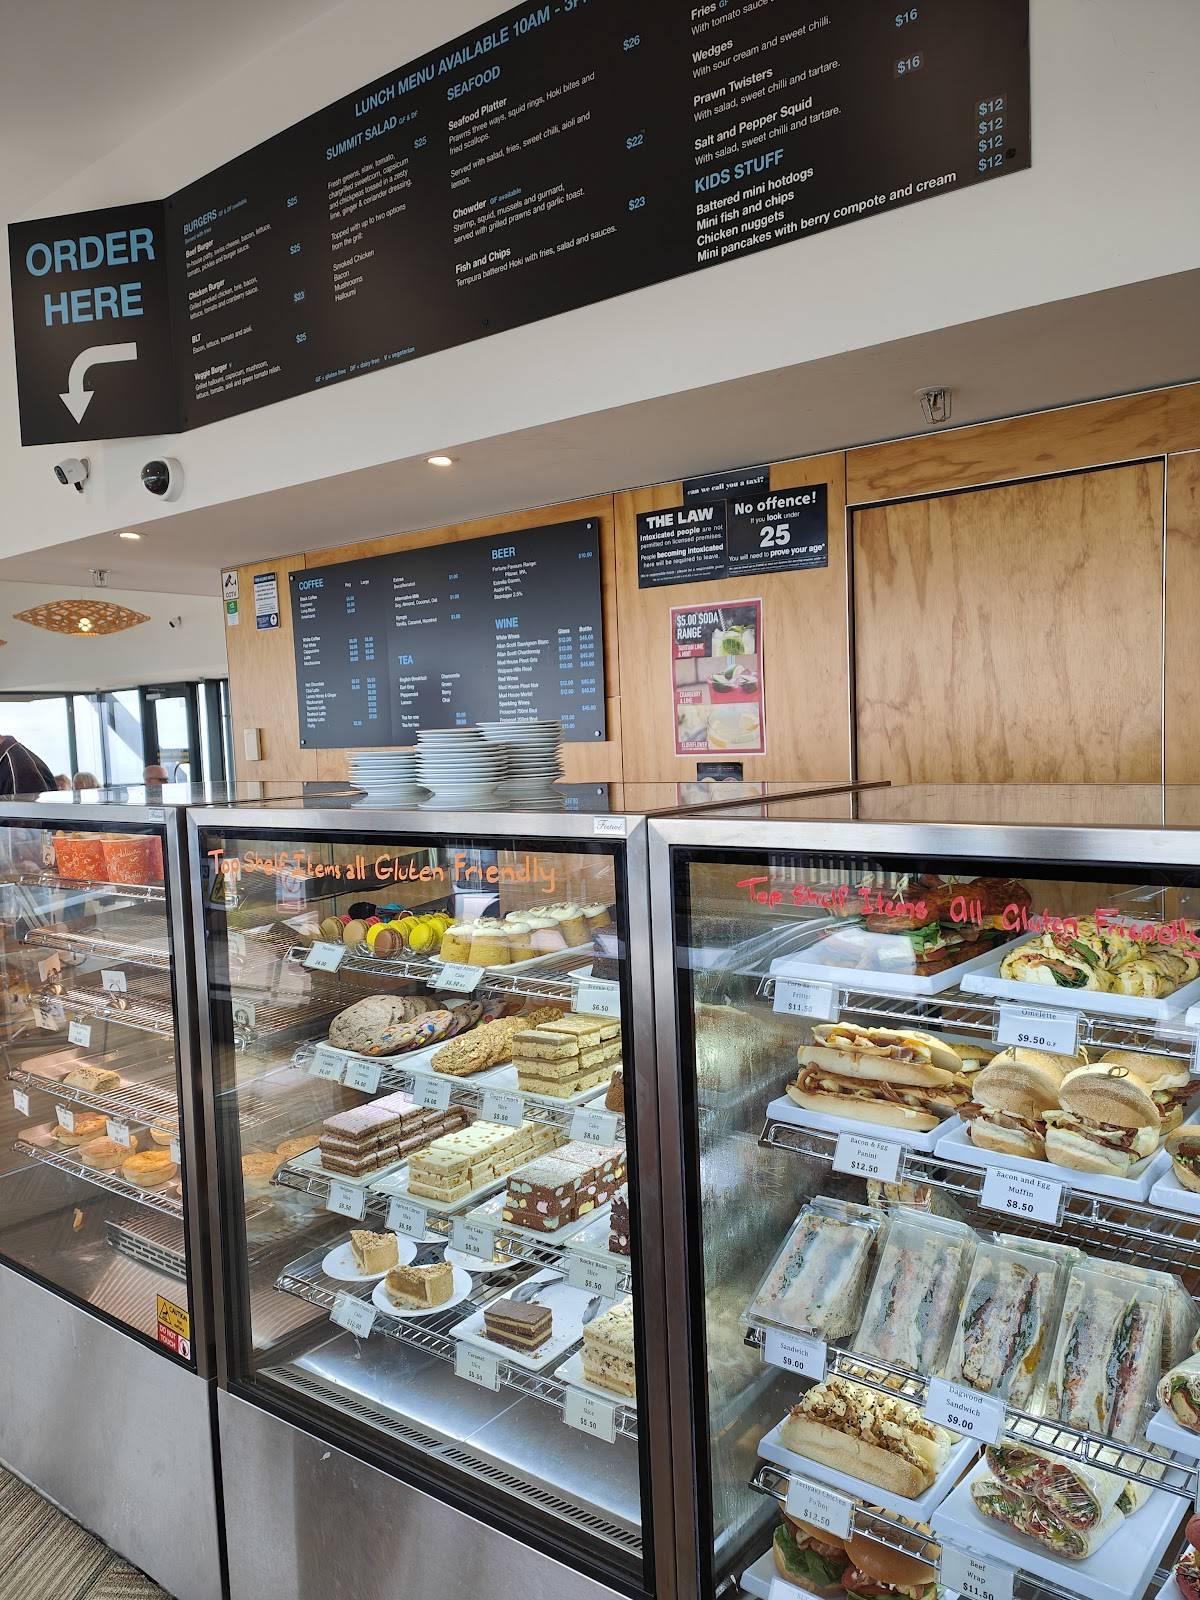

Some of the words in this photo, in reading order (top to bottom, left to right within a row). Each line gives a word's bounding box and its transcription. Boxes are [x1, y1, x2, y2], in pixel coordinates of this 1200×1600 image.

[691, 3, 717, 21] Fries
[895, 8, 918, 28] $16
[623, 35, 641, 52] $26
[692, 64, 711, 79] With
[712, 57, 732, 71] sour
[732, 47, 759, 63] cream
[761, 36, 778, 51] and
[779, 26, 806, 43] sweet
[808, 15, 832, 32] chilli.
[692, 39, 733, 63] Wedges
[355, 85, 395, 117] LUNCH
[398, 64, 435, 96] MENU
[438, 27, 509, 76] AVAILABLE
[512, 6, 550, 38] 10AM
[897, 55, 921, 74] $16
[447, 65, 501, 101] SEAFOOD
[693, 87, 726, 107] Prawn
[728, 68, 773, 93] Twisters
[448, 109, 480, 131] Seafood
[481, 97, 508, 119] Platter
[978, 98, 1004, 116] $12
[694, 133, 715, 150] Salt
[716, 126, 737, 142] and
[738, 111, 778, 134] Pepper
[780, 97, 813, 118] Squid
[978, 117, 1004, 135] $12
[326, 132, 363, 160] SUMMIT
[364, 116, 397, 142] SALAD
[413, 136, 428, 149] $25
[626, 134, 644, 150] $22
[694, 152, 714, 166] With
[715, 144, 740, 159] salad,
[741, 132, 767, 149] sweet
[768, 123, 789, 139] chilli
[790, 115, 807, 131] and
[809, 105, 841, 124] tartare.
[978, 135, 1003, 153] $12
[694, 169, 731, 193] KIDS
[734, 149, 784, 180] STUFF
[977, 154, 1003, 172] $12
[697, 191, 741, 216] Battered
[743, 184, 766, 200] mini
[768, 167, 814, 193] hotdogs
[452, 200, 487, 220] Chowder
[628, 196, 646, 211] $23
[697, 213, 718, 232] Mini
[720, 208, 740, 223] fish
[741, 202, 763, 217] and
[765, 189, 795, 211] chips
[183, 209, 218, 235] BURGERS
[697, 245, 719, 263] Mini
[721, 231, 772, 257] pancakes
[774, 223, 798, 238] with
[801, 211, 831, 232] berry
[833, 195, 886, 220] compote
[889, 184, 914, 200] and
[915, 171, 957, 193] cream
[697, 225, 739, 247] Chicken
[740, 209, 785, 234] nuggets
[26, 228, 155, 277] ORDER
[455, 260, 472, 275] Fish
[472, 255, 488, 268] and
[488, 248, 511, 263] Chips
[456, 271, 482, 287] Tempura
[482, 262, 508, 279] battered
[508, 256, 524, 270] Hoki
[525, 251, 539, 263] with
[539, 245, 556, 258] fries,
[556, 238, 575, 252] salad
[576, 233, 589, 246] and
[590, 225, 618, 241] sauces.
[44, 282, 144, 326] HERE
[701, 486, 710, 494] we
[711, 483, 725, 491] call
[725, 481, 739, 490] you
[734, 501, 754, 516] No
[756, 491, 817, 512] offence!
[646, 513, 673, 529] THE
[677, 507, 714, 524] LAW
[755, 516, 766, 524] you
[766, 512, 782, 521] look
[783, 511, 800, 519] under
[640, 530, 675, 541] Intoxicated
[676, 526, 701, 537] people
[760, 523, 791, 548] 25
[491, 546, 516, 560] BEER
[657, 548, 687, 559] becoming
[687, 543, 724, 554] intoxicated
[770, 548, 790, 558] prove
[791, 546, 808, 556] your
[299, 578, 324, 591] COFFEE
[495, 617, 519, 630] WINE
[676, 613, 697, 627] $5.00
[698, 611, 719, 624] SODA
[677, 626, 702, 640] RANGE
[398, 655, 414, 665] TEA
[207, 848, 240, 882] Top
[244, 850, 288, 876] Shelf
[289, 852, 342, 881] Items
[346, 857, 366, 880] all
[375, 856, 444, 883] Gluten
[454, 852, 557, 893] Friendly
[736, 875, 783, 907] Top
[858, 886, 929, 921] Items
[1001, 902, 1080, 938] Gluten
[788, 1003, 813, 1013] $11.50
[1021, 1008, 1057, 1020] Omelette
[1018, 1033, 1045, 1045] $9.50
[850, 1137, 869, 1147] Bacon
[857, 1150, 877, 1160] Panini
[850, 1160, 879, 1174] $12.50
[996, 1170, 1018, 1181] Bacon
[1020, 1177, 1035, 1186] and
[1037, 1180, 1051, 1191] Egg
[1008, 1186, 1034, 1198] Muffin
[1006, 1199, 1034, 1213] $8.50
[780, 1342, 809, 1357] Sandwich
[782, 1356, 804, 1370] $9.00
[948, 1386, 983, 1404] Dagwood
[946, 1398, 981, 1417] Sandwich
[947, 1414, 974, 1430] $9.00
[803, 1508, 830, 1527] $12.50
[970, 1560, 986, 1572] Beef
[967, 1570, 986, 1585] Wrap
[962, 1582, 994, 1600] $11.50
